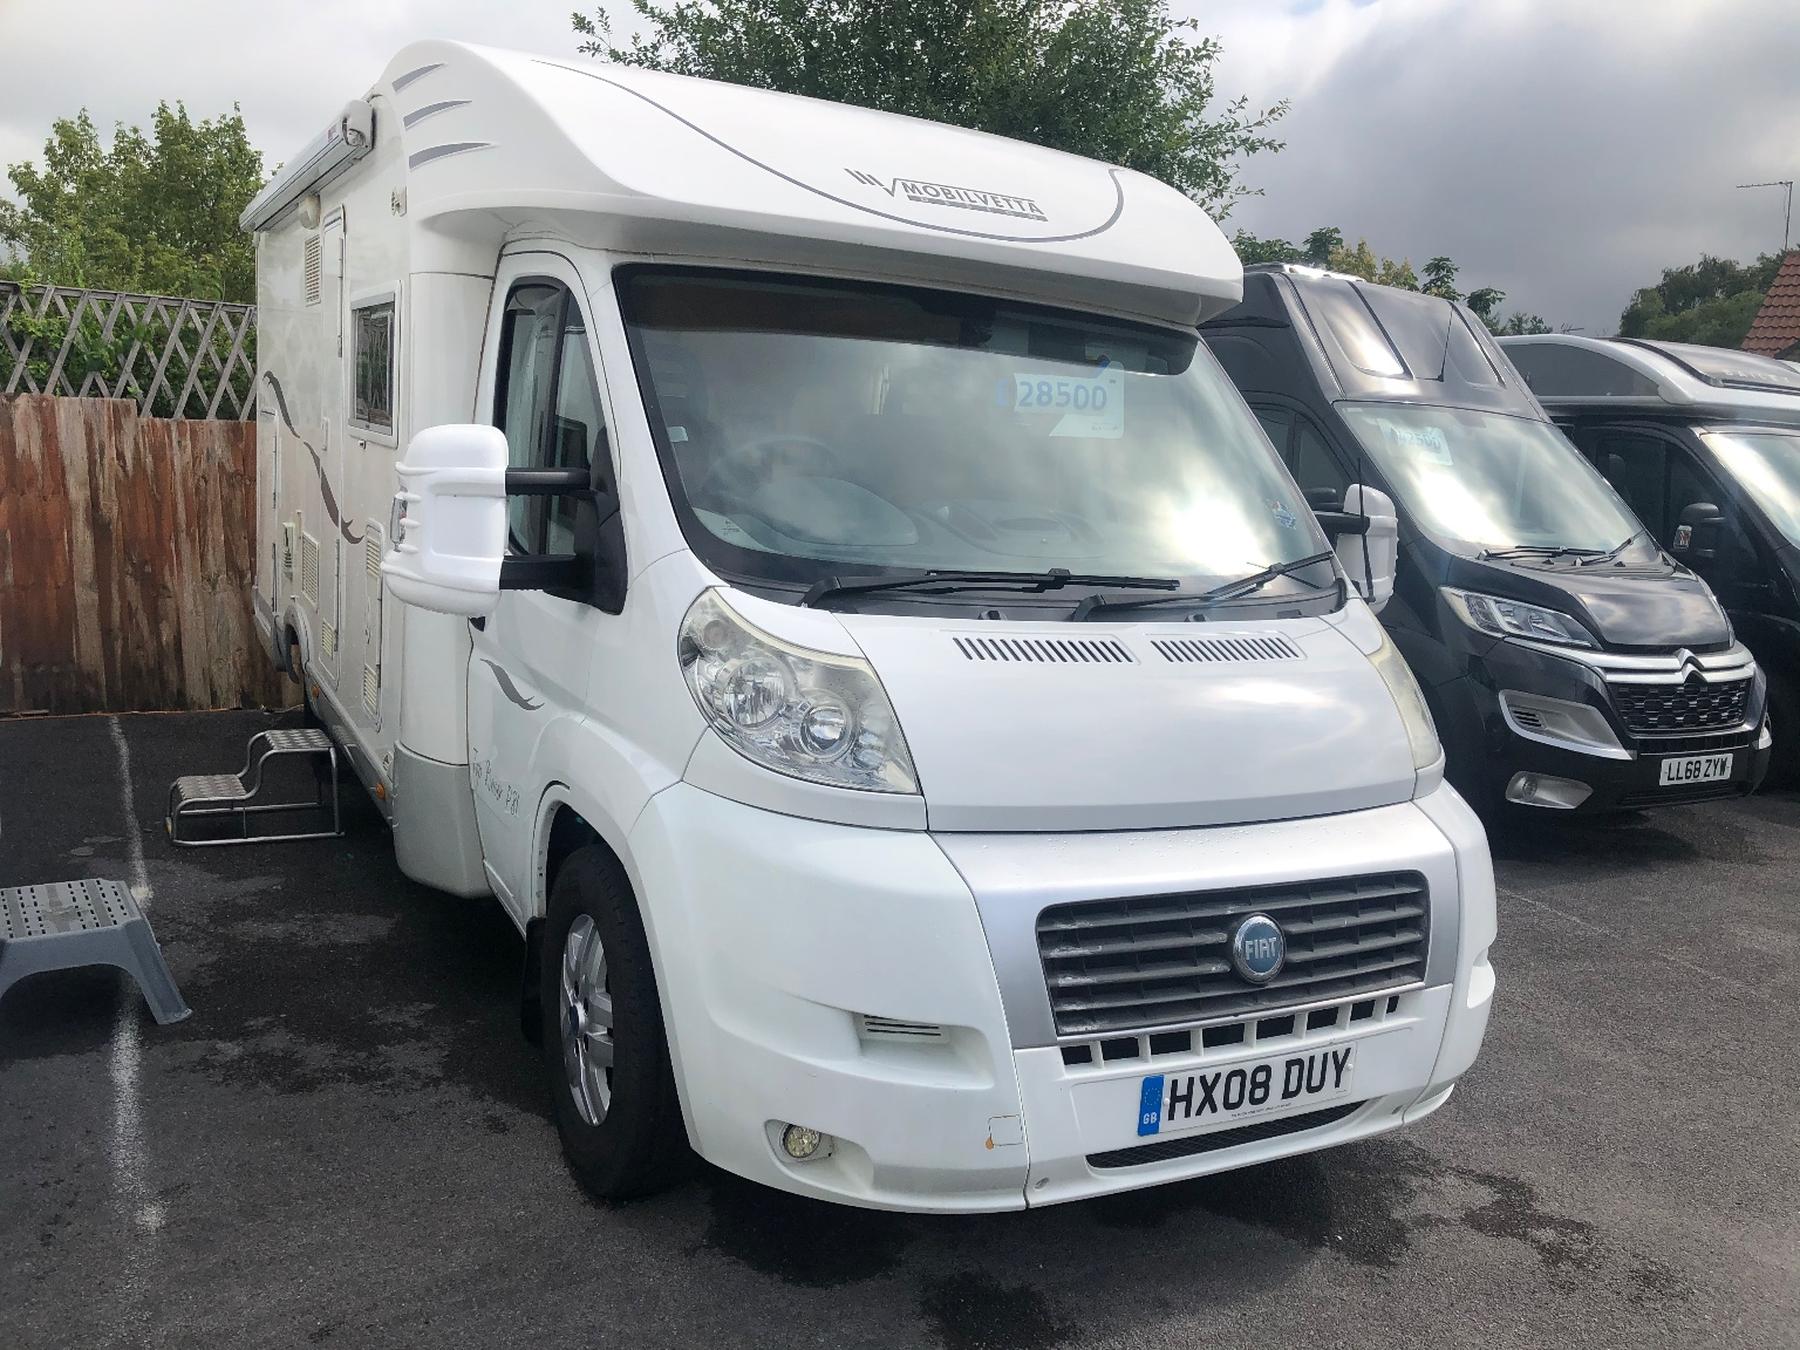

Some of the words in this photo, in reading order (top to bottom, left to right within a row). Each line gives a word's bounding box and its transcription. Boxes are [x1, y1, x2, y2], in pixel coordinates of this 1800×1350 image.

[901, 181, 1045, 215] MOBILVETTA
[1667, 760, 1701, 781] LL68
[1703, 756, 1728, 778] ZYW
[1244, 936, 1277, 960] FIAT
[1167, 1064, 1272, 1121] HX08
[1281, 1047, 1352, 1100] DUY
[1143, 1111, 1158, 1125] GB
